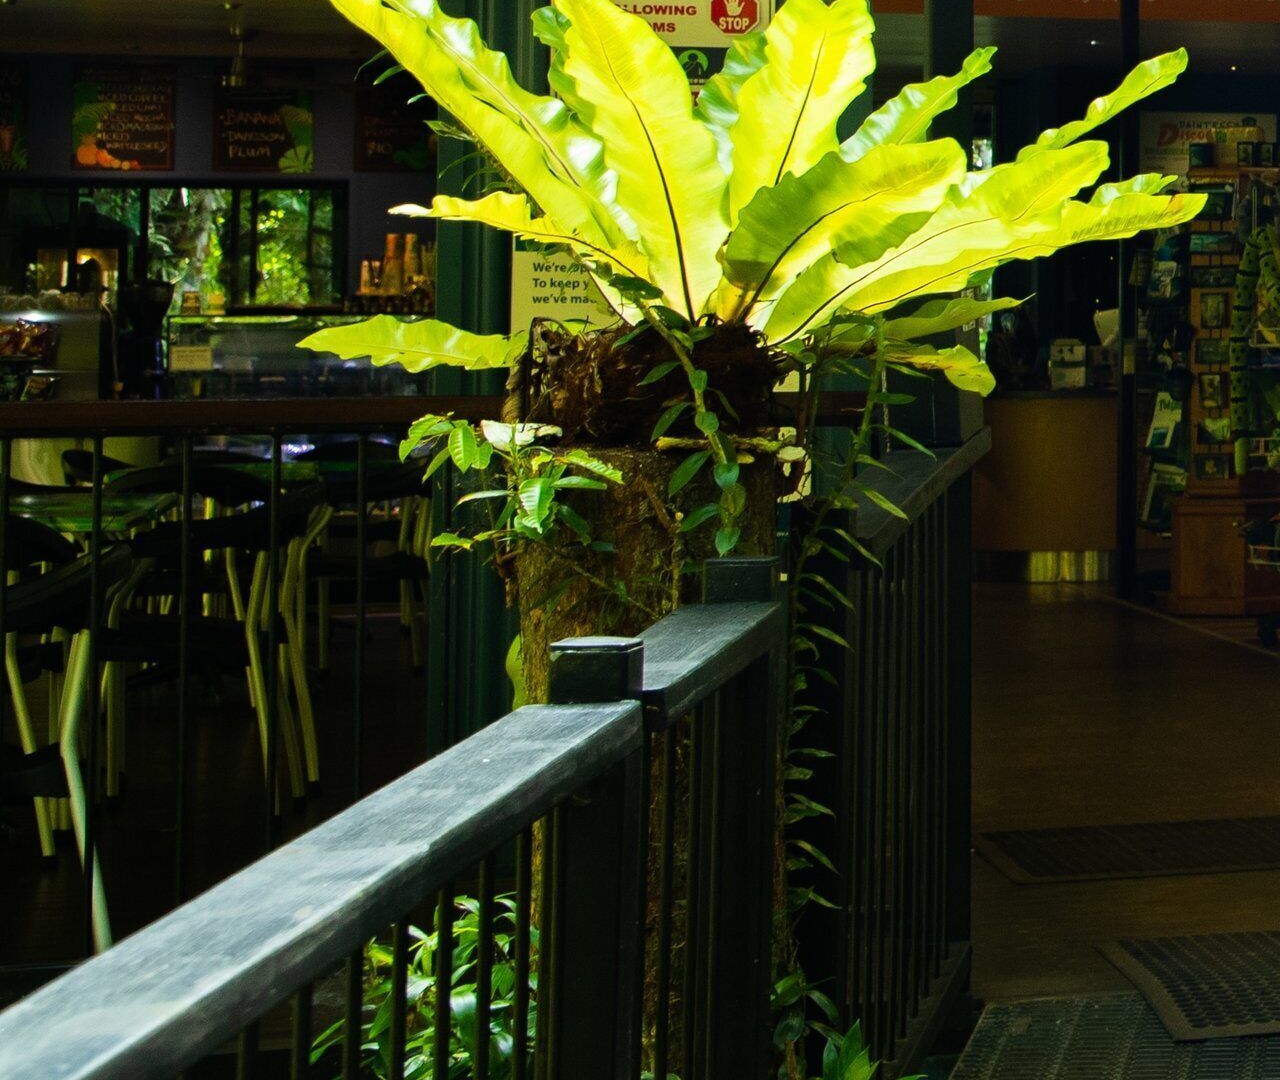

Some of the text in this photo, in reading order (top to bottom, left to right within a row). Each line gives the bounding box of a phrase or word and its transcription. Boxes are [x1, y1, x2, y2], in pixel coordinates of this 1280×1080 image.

[719, 16, 750, 31] STOP
[532, 262, 567, 273] We're
[532, 278, 547, 288] To
[550, 277, 581, 291] keep
[532, 294, 568, 304] we've
